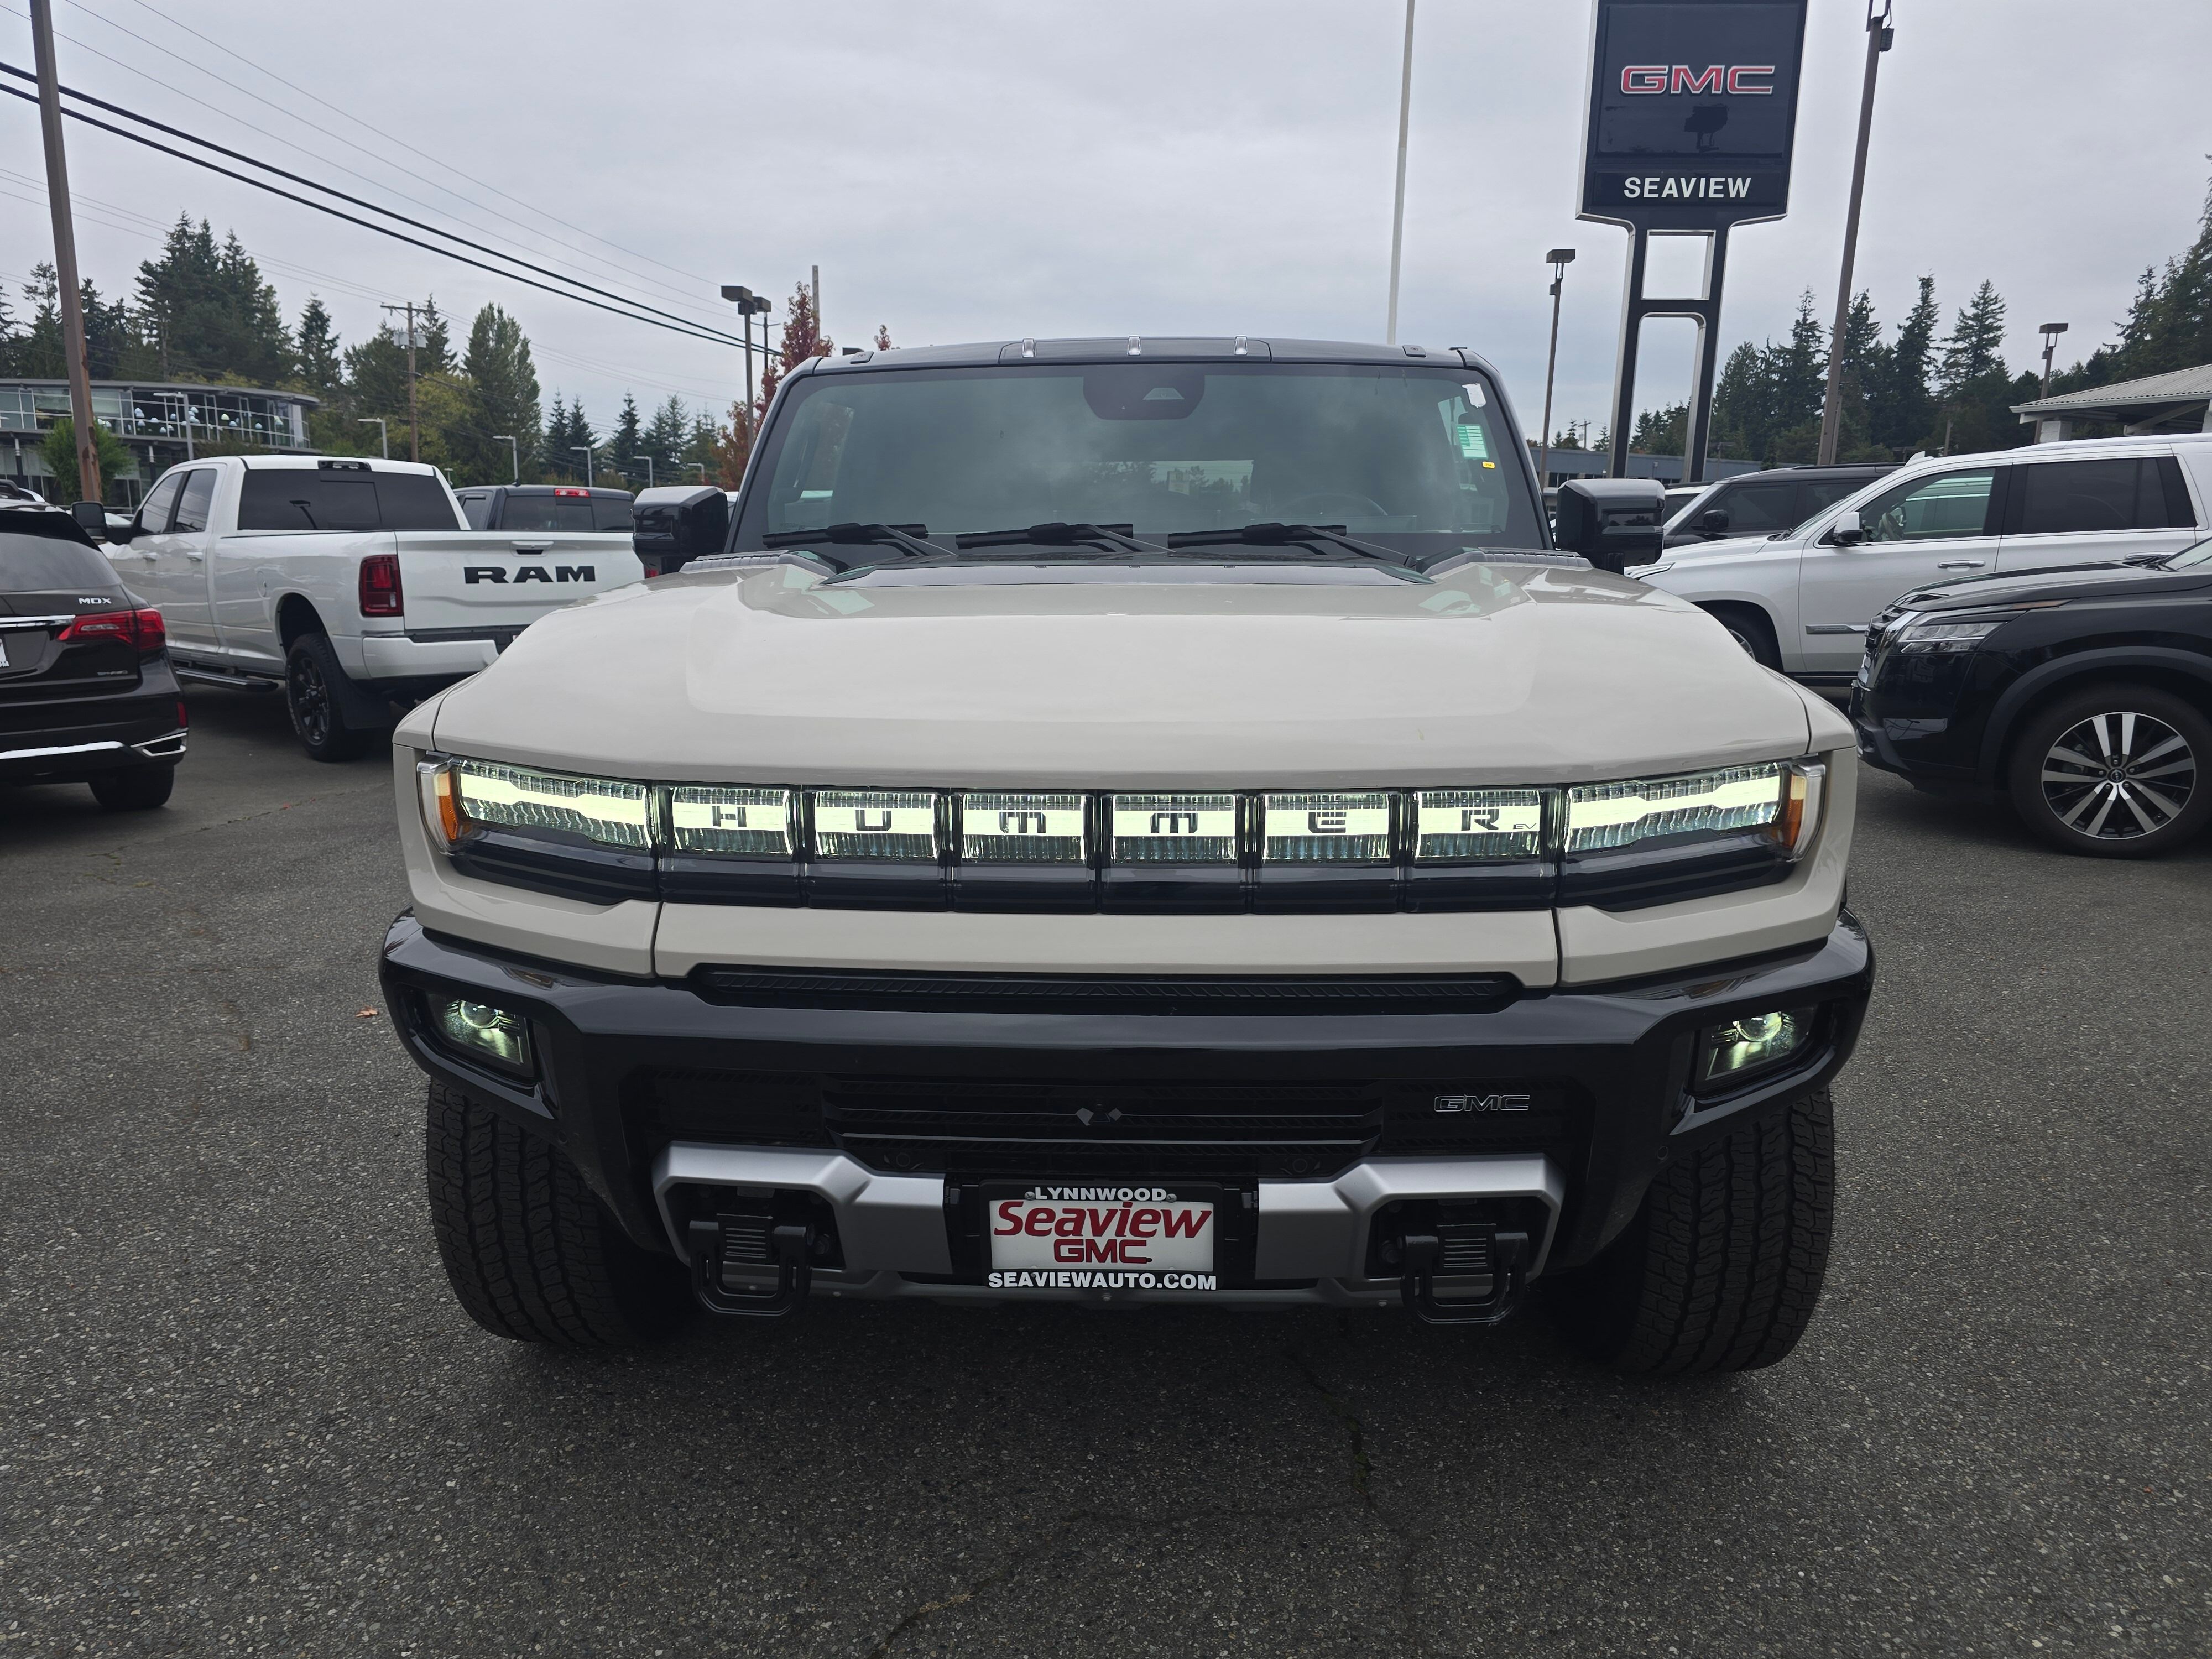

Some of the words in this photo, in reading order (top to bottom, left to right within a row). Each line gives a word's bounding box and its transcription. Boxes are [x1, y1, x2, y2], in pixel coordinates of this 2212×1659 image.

[1621, 65, 1775, 95] GMC
[1624, 176, 1751, 199] SEAVIEW
[464, 566, 596, 584] RAM
[712, 806, 1499, 834] HUMMER
[1434, 1094, 1530, 1112] GMC
[1035, 1187, 1167, 1202] LYNNWOOD
[993, 1201, 1212, 1238] Seaview
[1053, 1239, 1147, 1264] GMC
[988, 1272, 1217, 1290] SEAVIEWAUTO.COM
